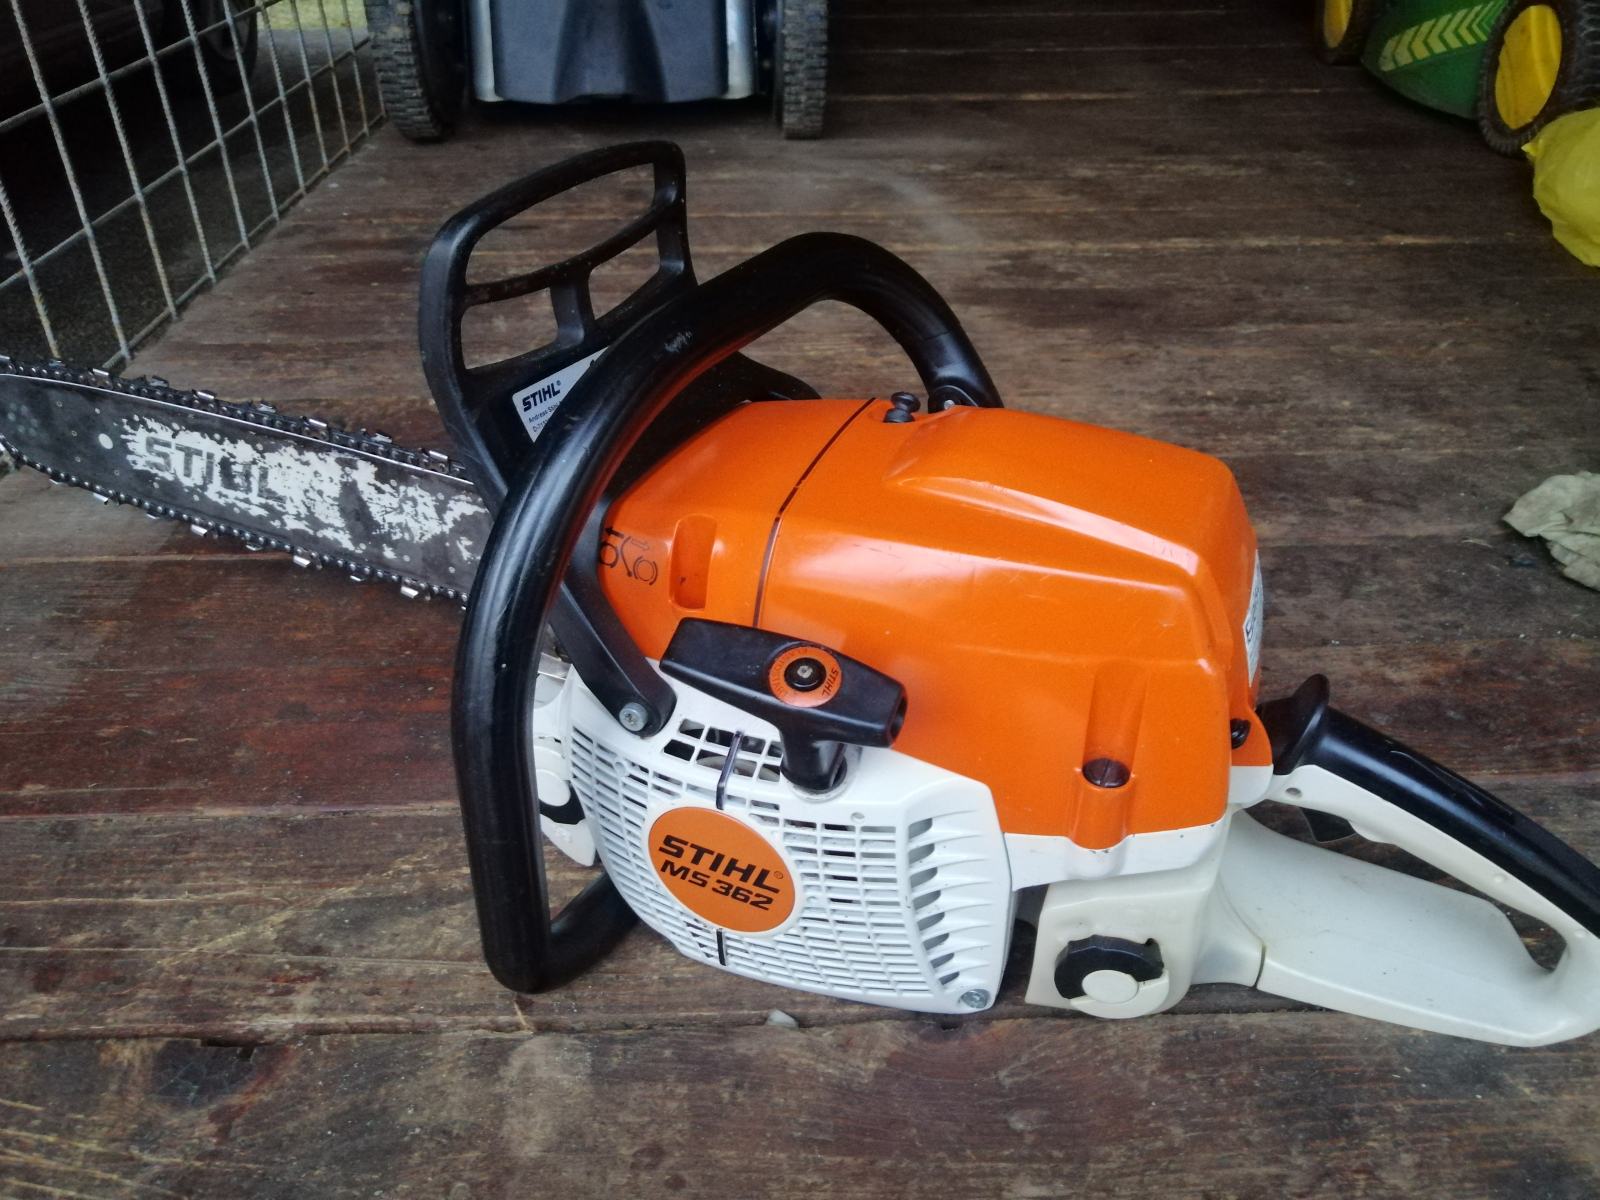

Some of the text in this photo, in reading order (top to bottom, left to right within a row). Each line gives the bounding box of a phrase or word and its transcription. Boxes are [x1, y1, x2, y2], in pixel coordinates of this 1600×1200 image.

[522, 382, 561, 412] STIHL
[821, 666, 840, 697] STIHL
[658, 834, 780, 894] STIHL
[660, 859, 774, 911] MS 362
